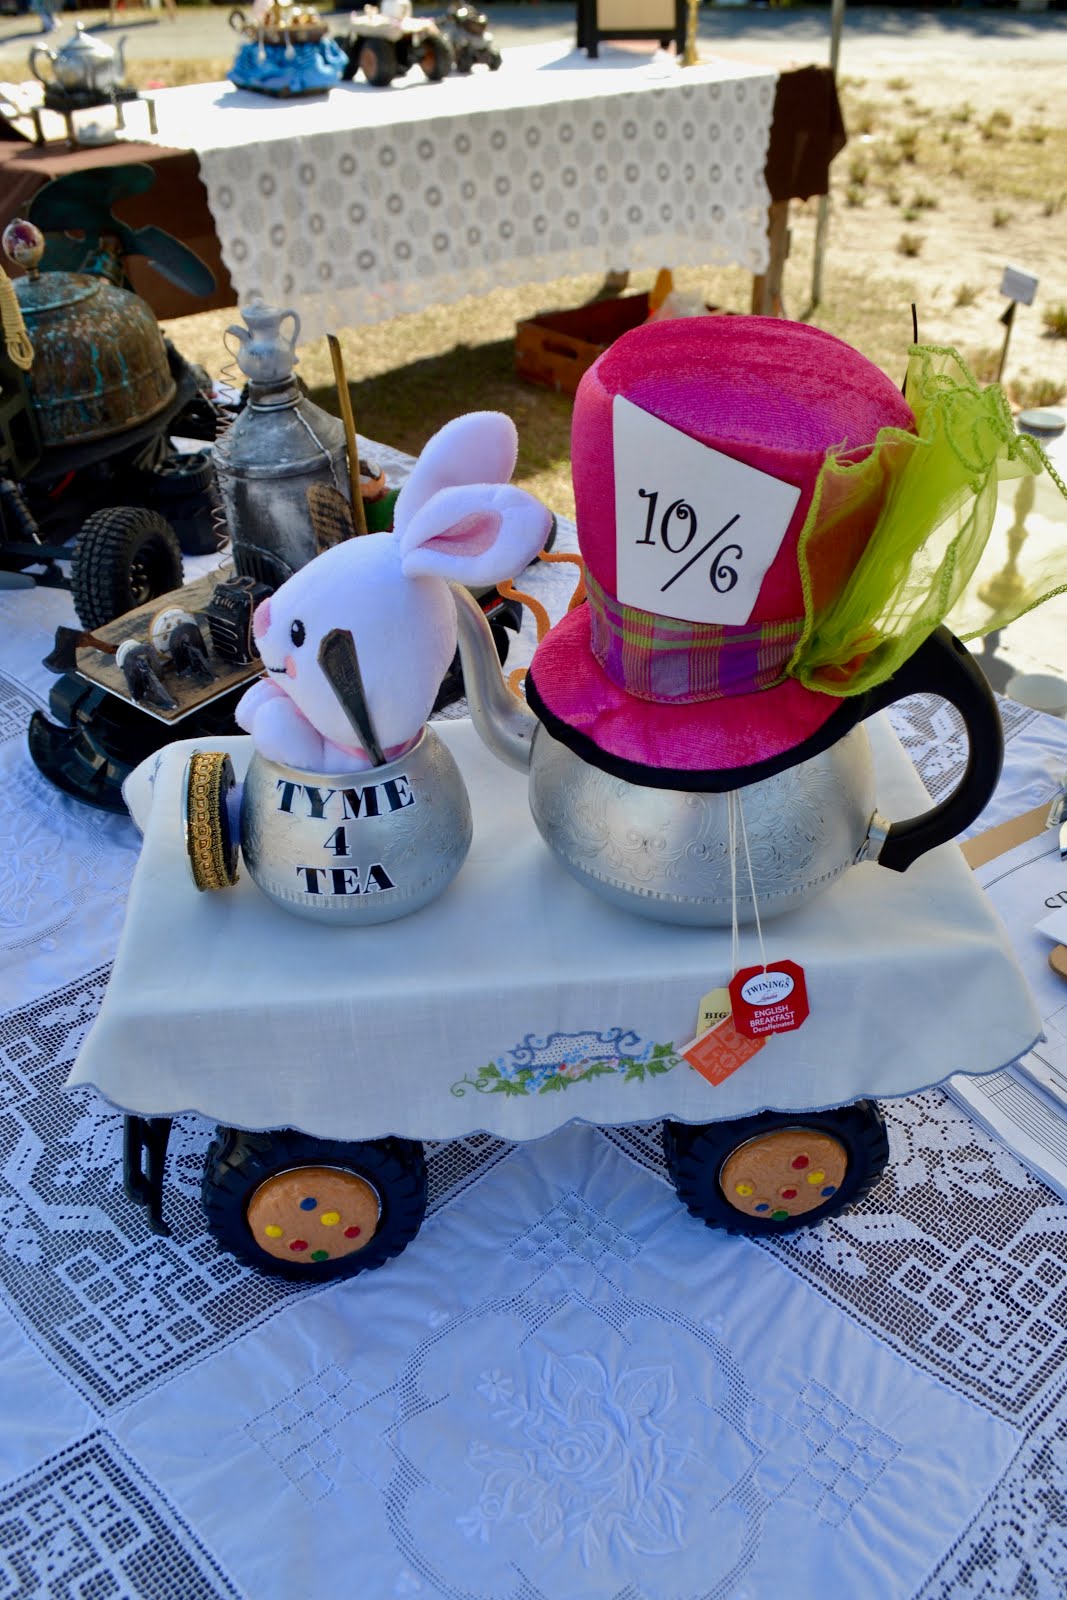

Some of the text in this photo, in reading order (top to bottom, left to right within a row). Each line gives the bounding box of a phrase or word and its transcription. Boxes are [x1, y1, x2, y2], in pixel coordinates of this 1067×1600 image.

[636, 488, 743, 593] 10/6
[276, 775, 415, 820] TYME
[323, 826, 350, 856] 4
[296, 864, 396, 895] TEA
[745, 978, 790, 996] TWININGS
[704, 1012, 730, 1020] BIG
[750, 1011, 795, 1027] BREAKFAST
[754, 1004, 789, 1018] ENGLISH
[752, 1018, 795, 1033] Decaffeinated
